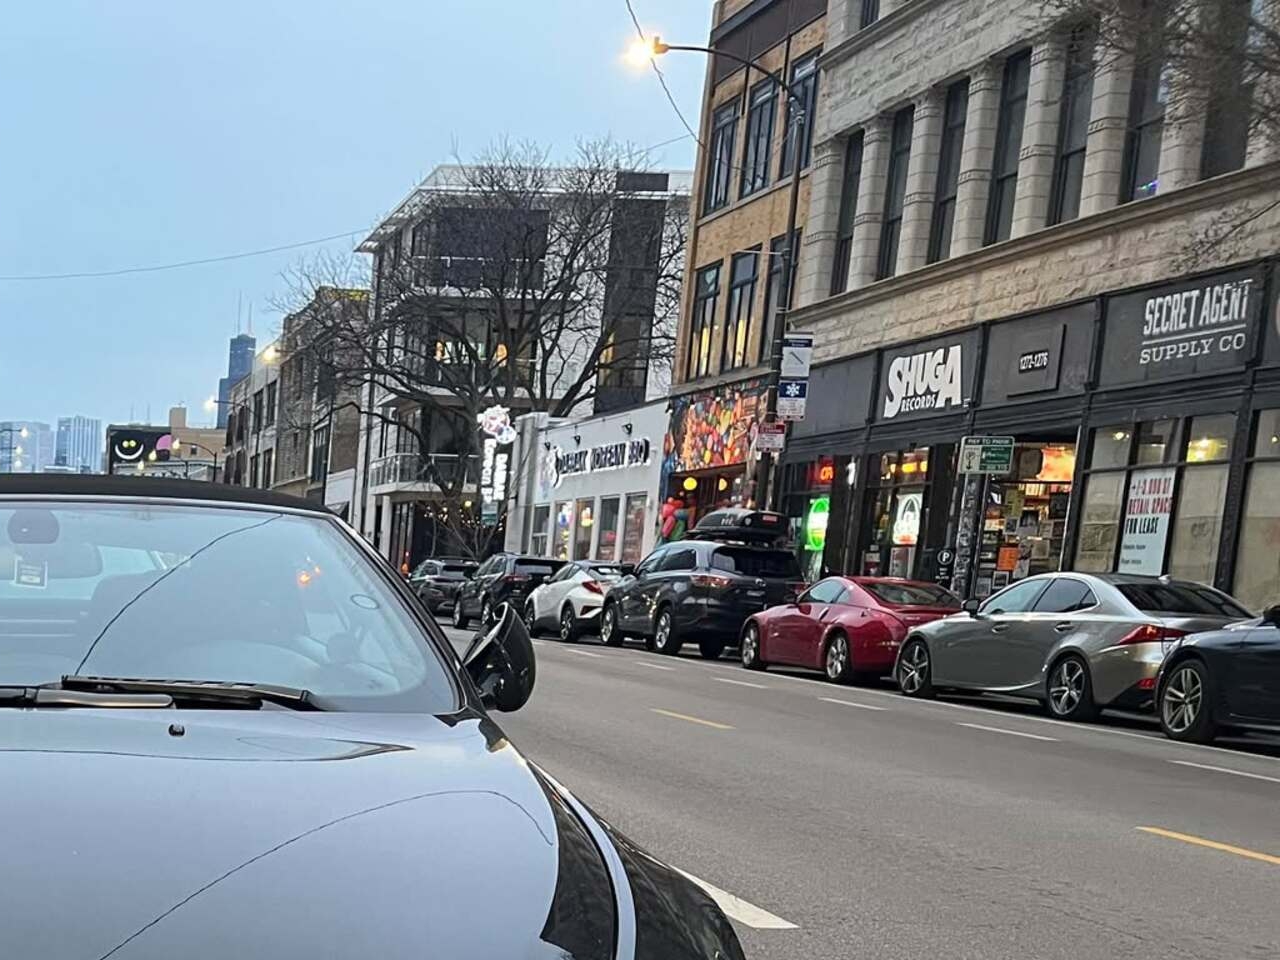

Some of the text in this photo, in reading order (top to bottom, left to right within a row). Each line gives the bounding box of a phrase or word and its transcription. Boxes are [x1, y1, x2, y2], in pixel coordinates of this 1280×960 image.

[1143, 279, 1253, 335] SECRET AGENT
[1139, 333, 1246, 364] SUPPLY CO
[883, 344, 961, 418] SHUGA
[901, 394, 936, 412] RECORDS
[1125, 517, 1159, 534] FOR LEASE
